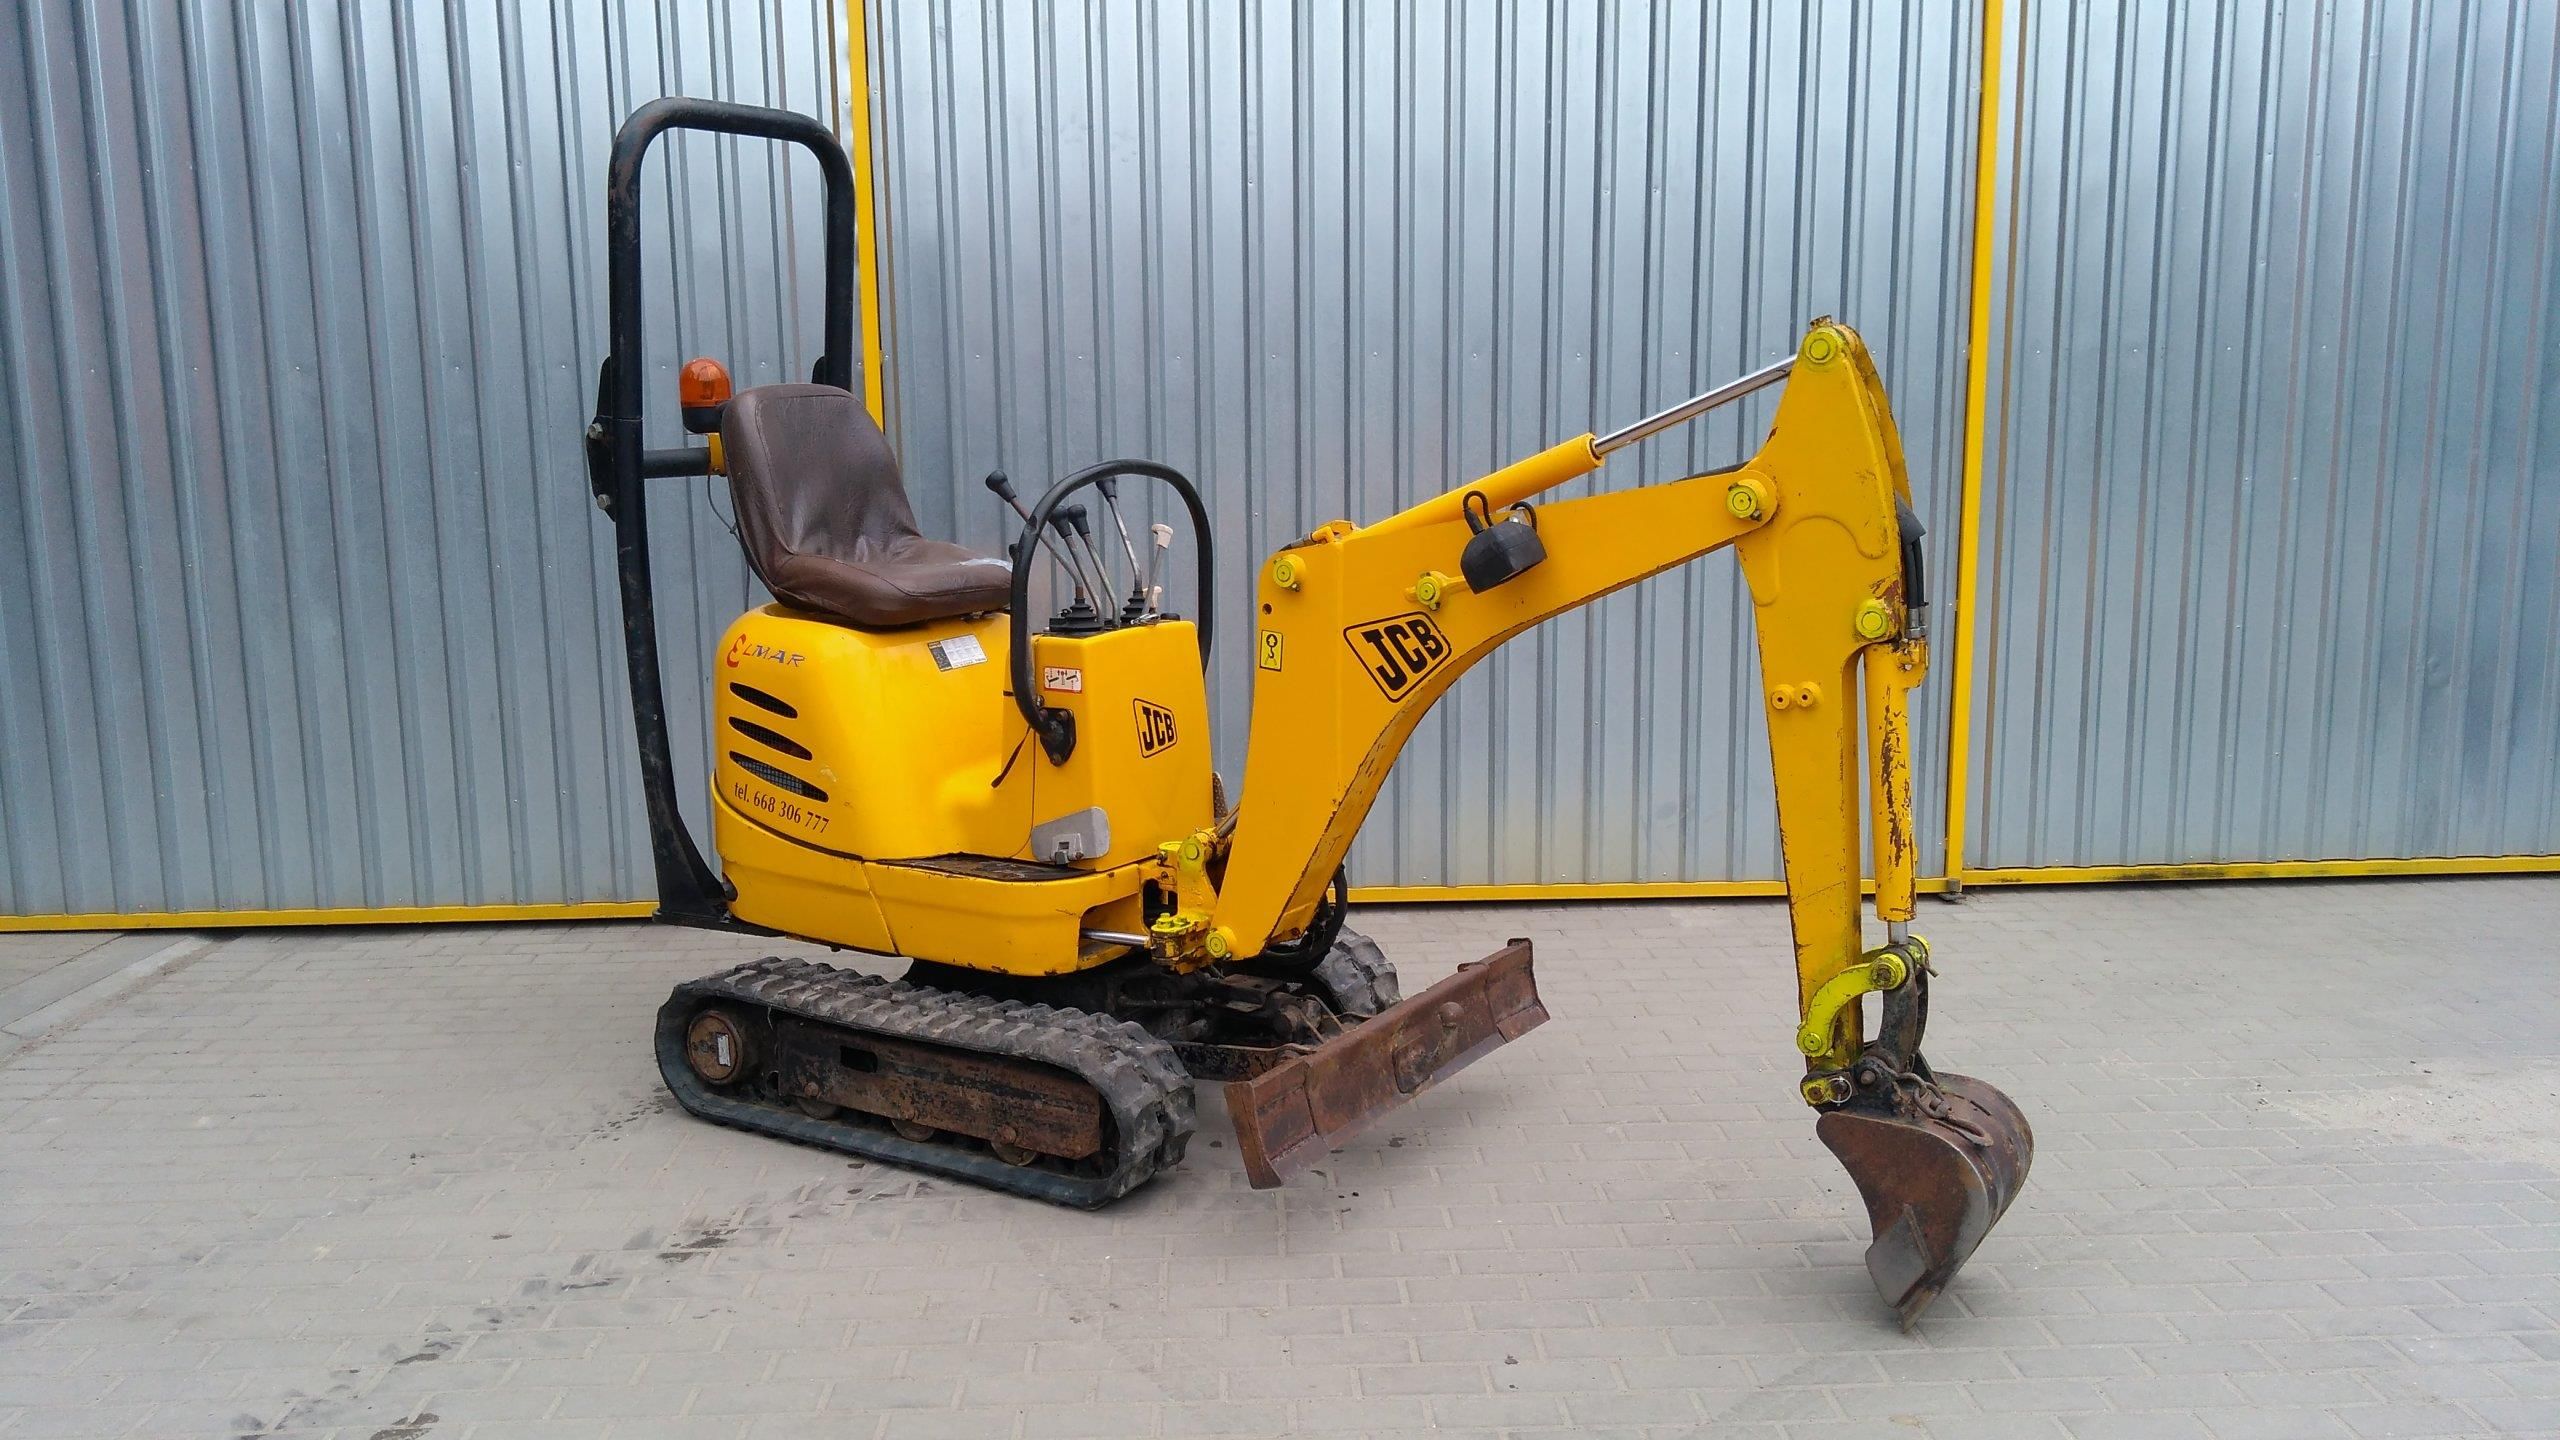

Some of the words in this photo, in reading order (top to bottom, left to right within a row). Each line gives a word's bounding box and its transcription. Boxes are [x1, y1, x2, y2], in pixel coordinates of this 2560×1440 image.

[726, 633, 806, 668] ELMAR
[1360, 618, 1445, 691] JCB
[1141, 705, 1175, 752] JCB
[733, 782, 750, 803] tel.
[753, 790, 776, 813] 668
[778, 800, 801, 824] 306
[804, 810, 830, 834] 777
